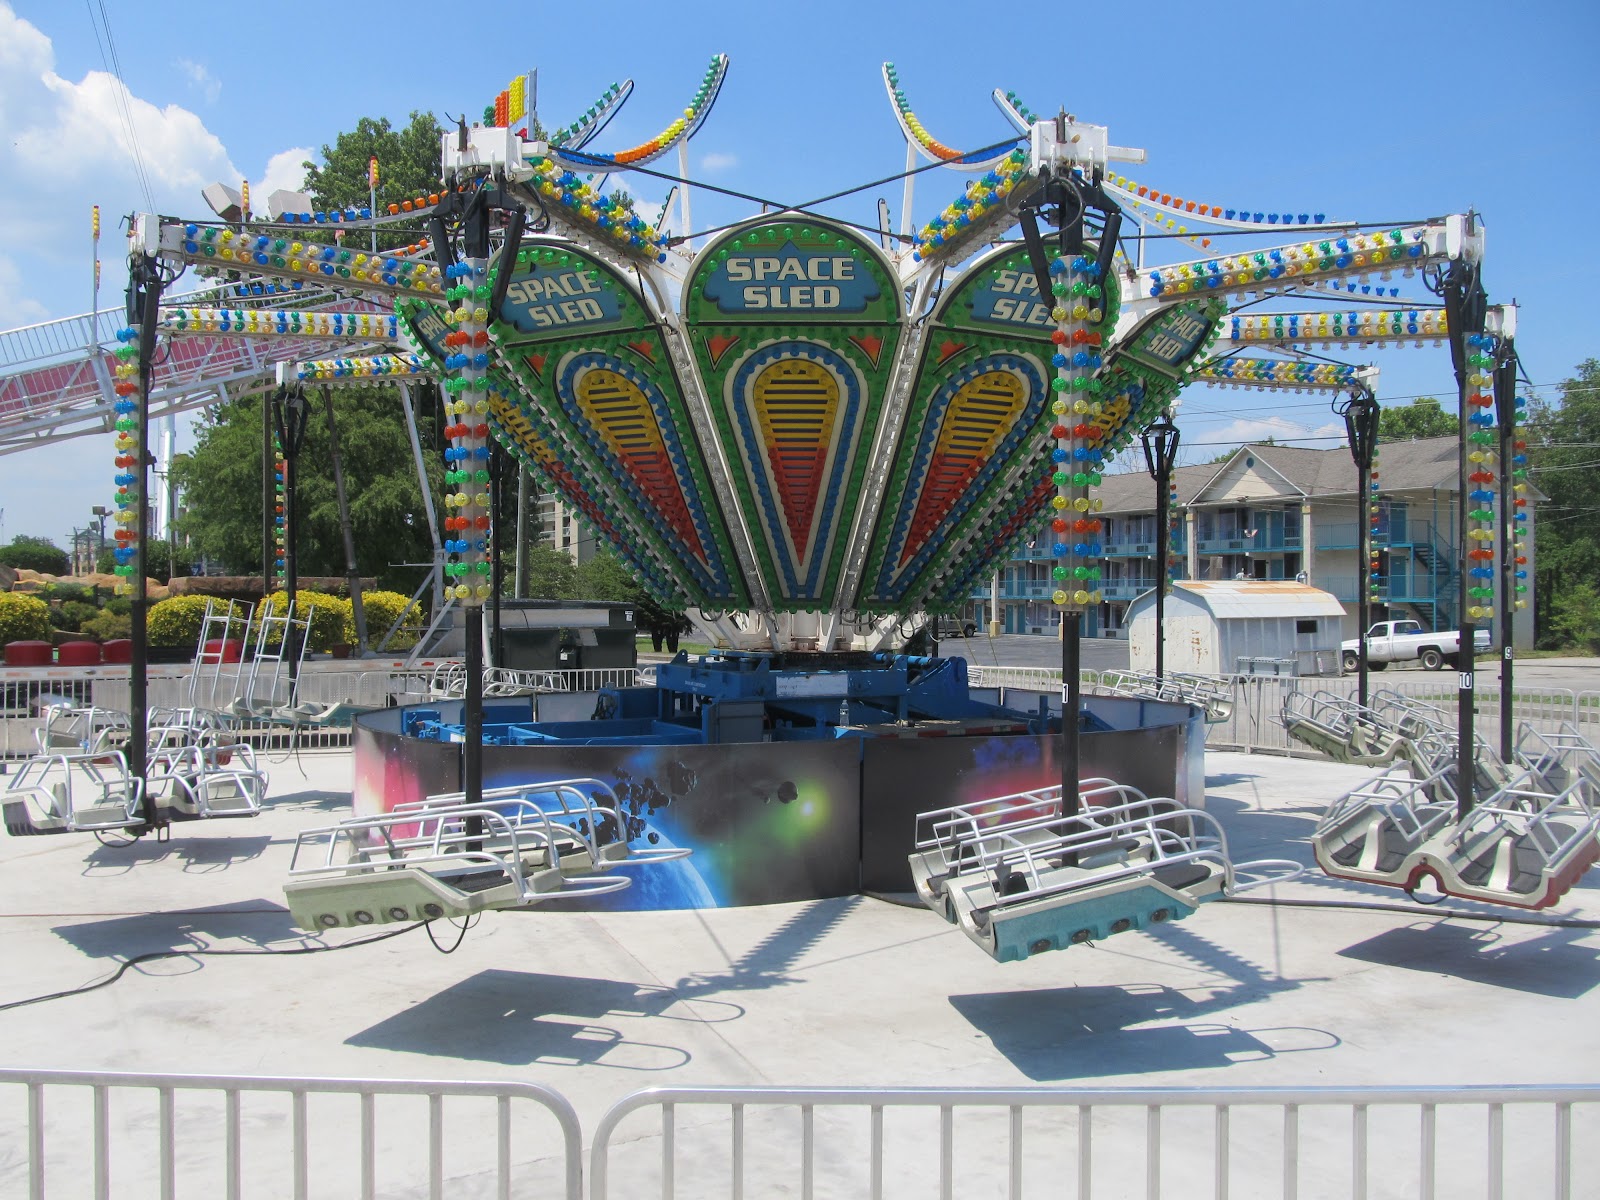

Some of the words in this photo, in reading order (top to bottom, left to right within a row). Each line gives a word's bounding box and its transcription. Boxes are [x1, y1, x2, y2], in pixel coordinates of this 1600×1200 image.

[727, 258, 855, 281] SPACE
[507, 270, 602, 305] SPACE
[744, 286, 840, 308] SLED
[528, 299, 604, 327] SLED
[990, 298, 1058, 327] SLE
[1145, 333, 1182, 360] SLED
[1505, 647, 1512, 659] 9
[1460, 673, 1472, 688] 10
